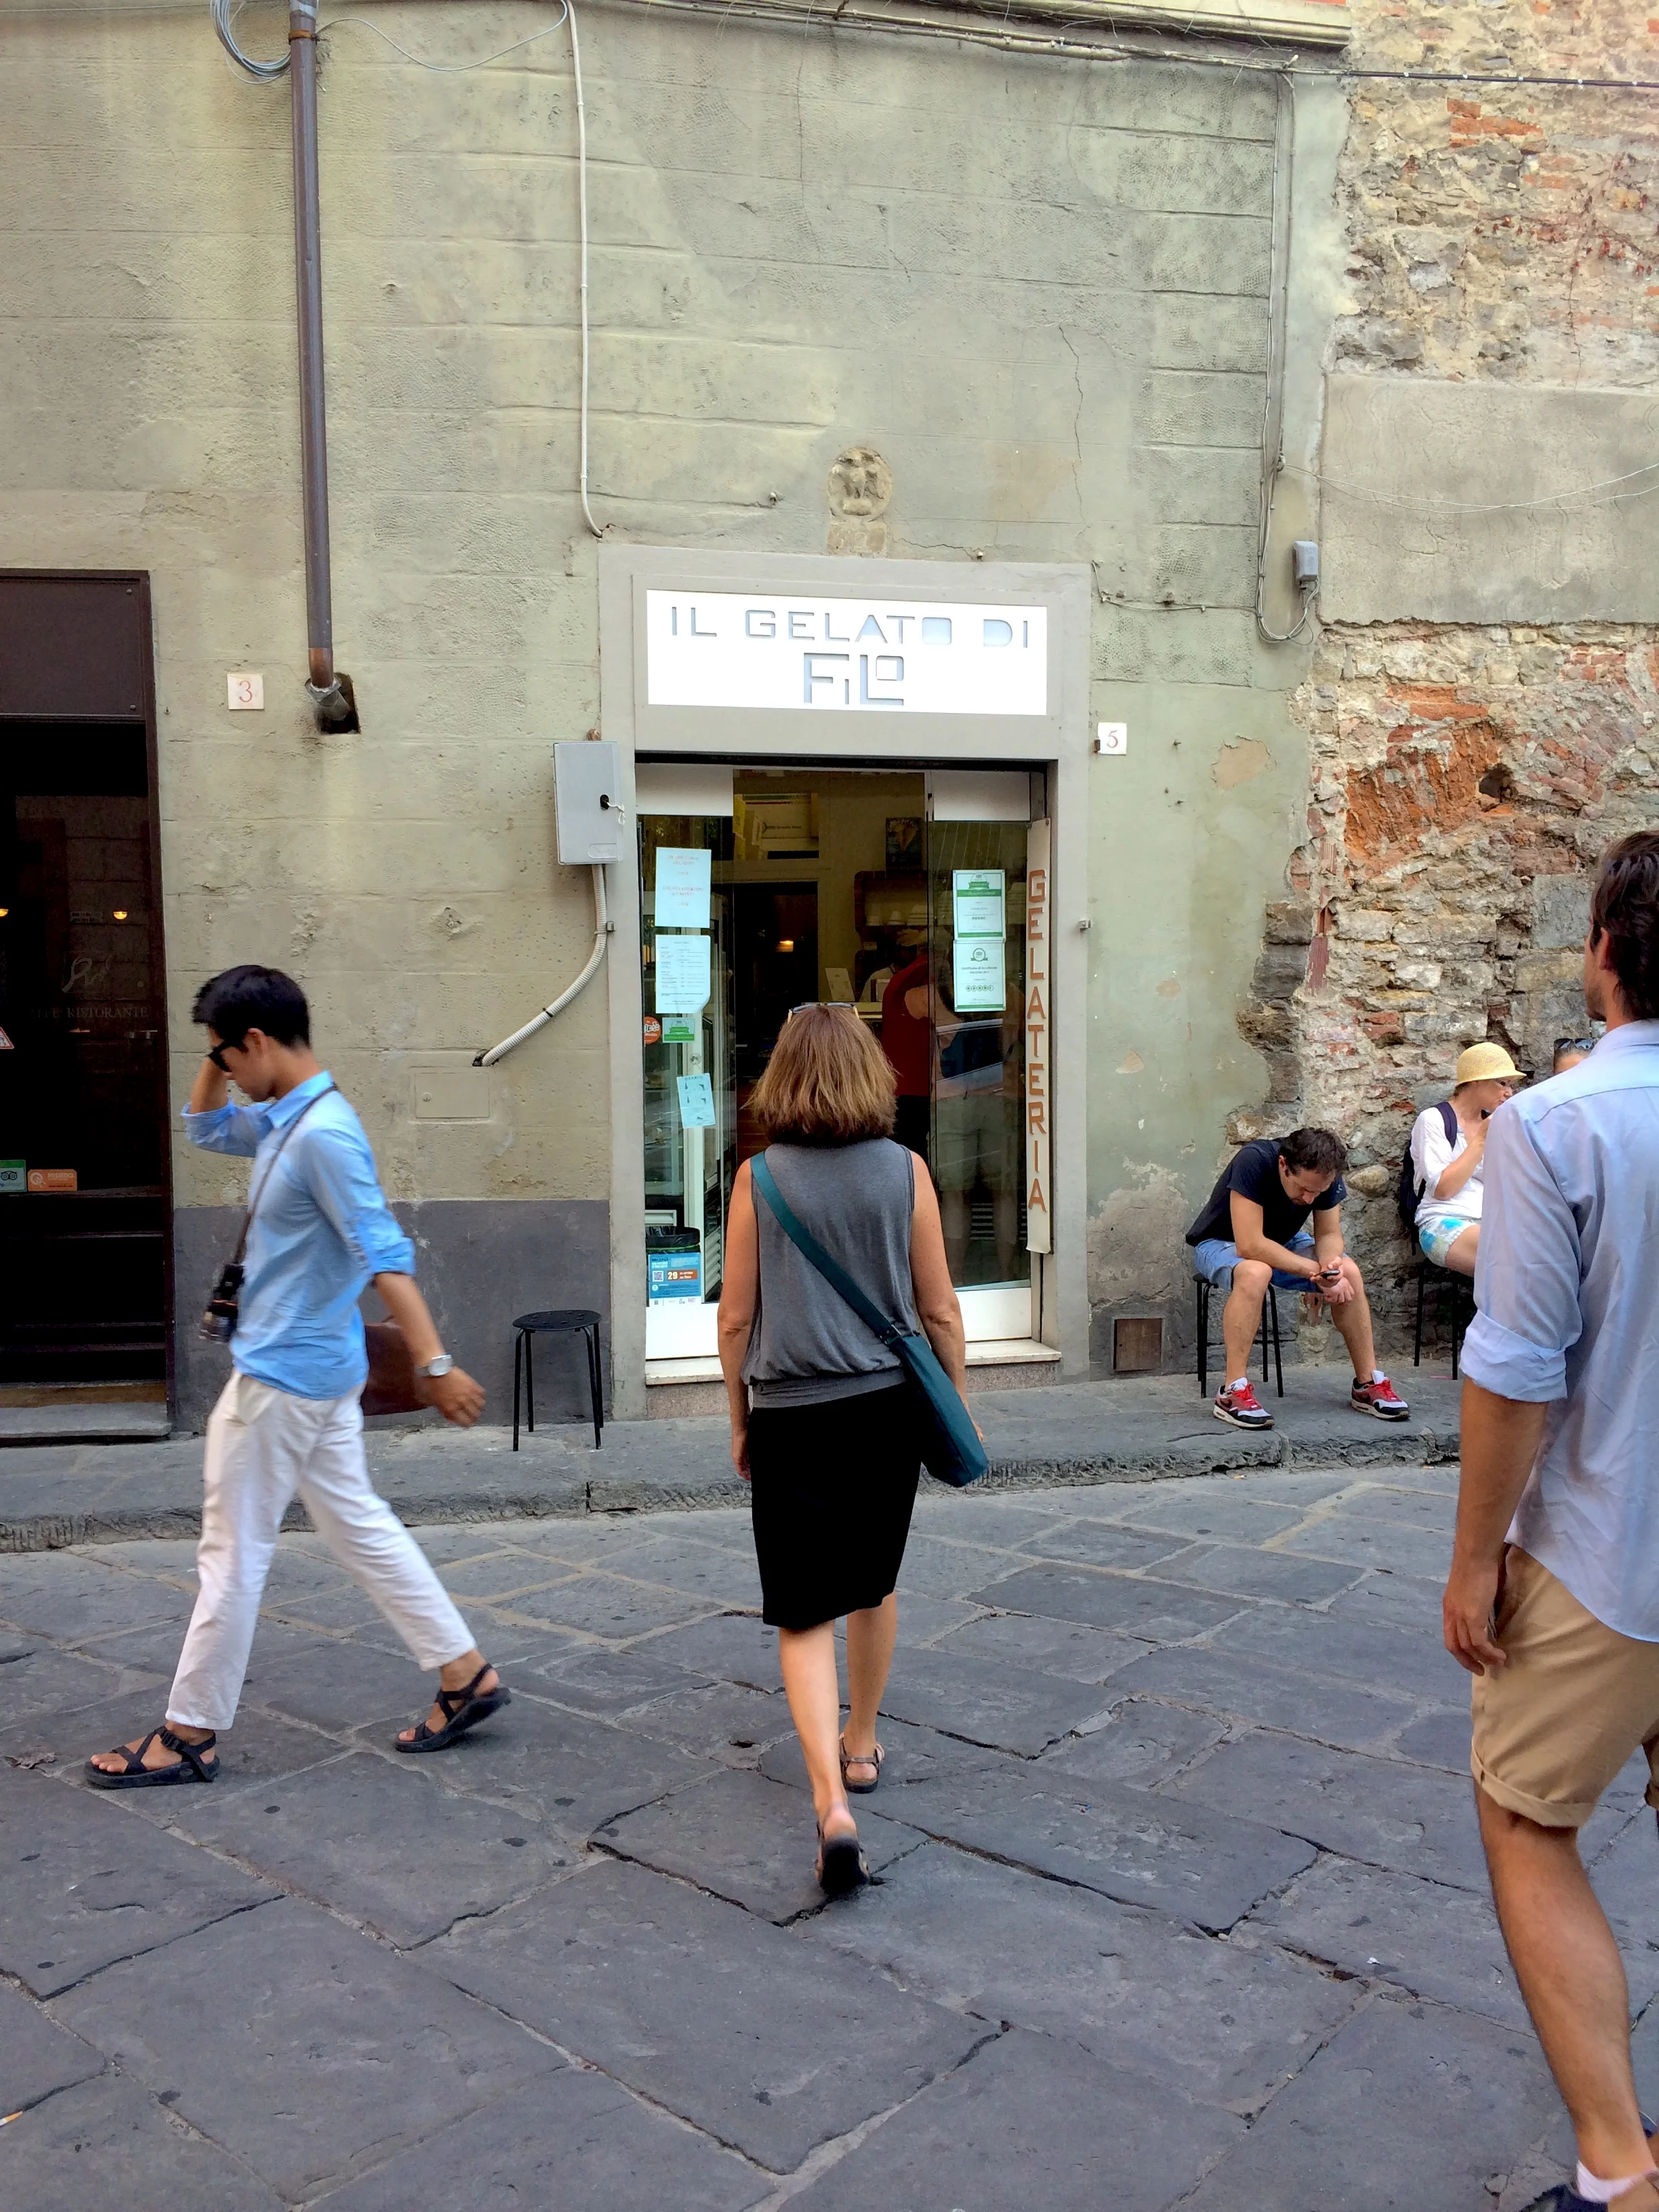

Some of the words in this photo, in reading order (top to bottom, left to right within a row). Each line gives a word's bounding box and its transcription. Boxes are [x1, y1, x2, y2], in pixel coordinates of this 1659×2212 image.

[672, 607, 717, 636] IL
[745, 609, 953, 645] GELATO
[983, 619, 1029, 649] DI
[239, 680, 253, 703] 3
[1106, 729, 1118, 748] 5
[66, 1006, 148, 1019] RISTORANTE
[1026, 869, 1047, 1214] GELATERIA
[668, 1271, 678, 1280] 29
